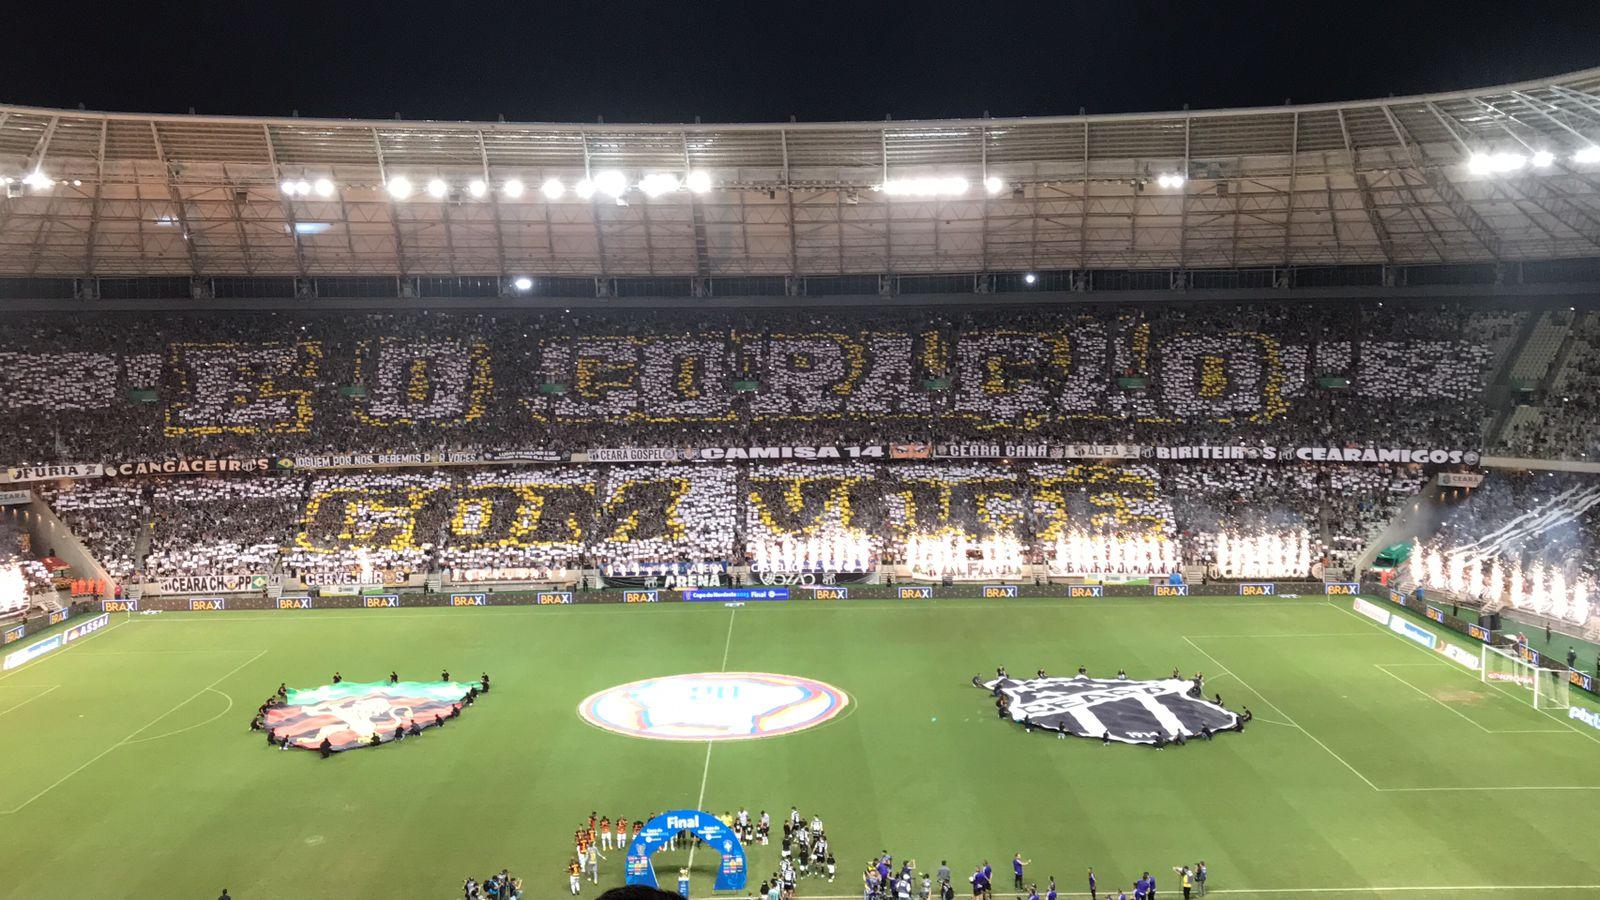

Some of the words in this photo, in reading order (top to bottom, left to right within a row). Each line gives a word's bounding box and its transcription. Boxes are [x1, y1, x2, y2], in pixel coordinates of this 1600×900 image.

[631, 449, 663, 460] GOSPEL
[701, 446, 840, 459] CAMISA
[843, 446, 884, 458] 14
[1087, 445, 1119, 456] ALFA
[294, 456, 330, 467] JOGUEM
[333, 456, 352, 466] POR
[379, 454, 421, 464] BEBEMOS
[665, 575, 721, 588] ARENA
[902, 589, 930, 598] BRAX
[986, 588, 1014, 597] BRAX
[1072, 588, 1100, 597] BRAX
[1157, 587, 1185, 596] BRAX
[1243, 586, 1271, 595] BRAX
[1328, 585, 1357, 594] BRAX
[627, 593, 655, 602] BRAX
[817, 590, 845, 599] BRAX
[280, 599, 309, 608] BRAX
[367, 598, 395, 607] BRAX
[454, 596, 482, 605] BRAX
[541, 595, 569, 604] BRAX
[106, 602, 134, 612] BRAX
[193, 601, 222, 610] BRAX
[1570, 671, 1589, 690] BRAX
[667, 815, 699, 829] Final
